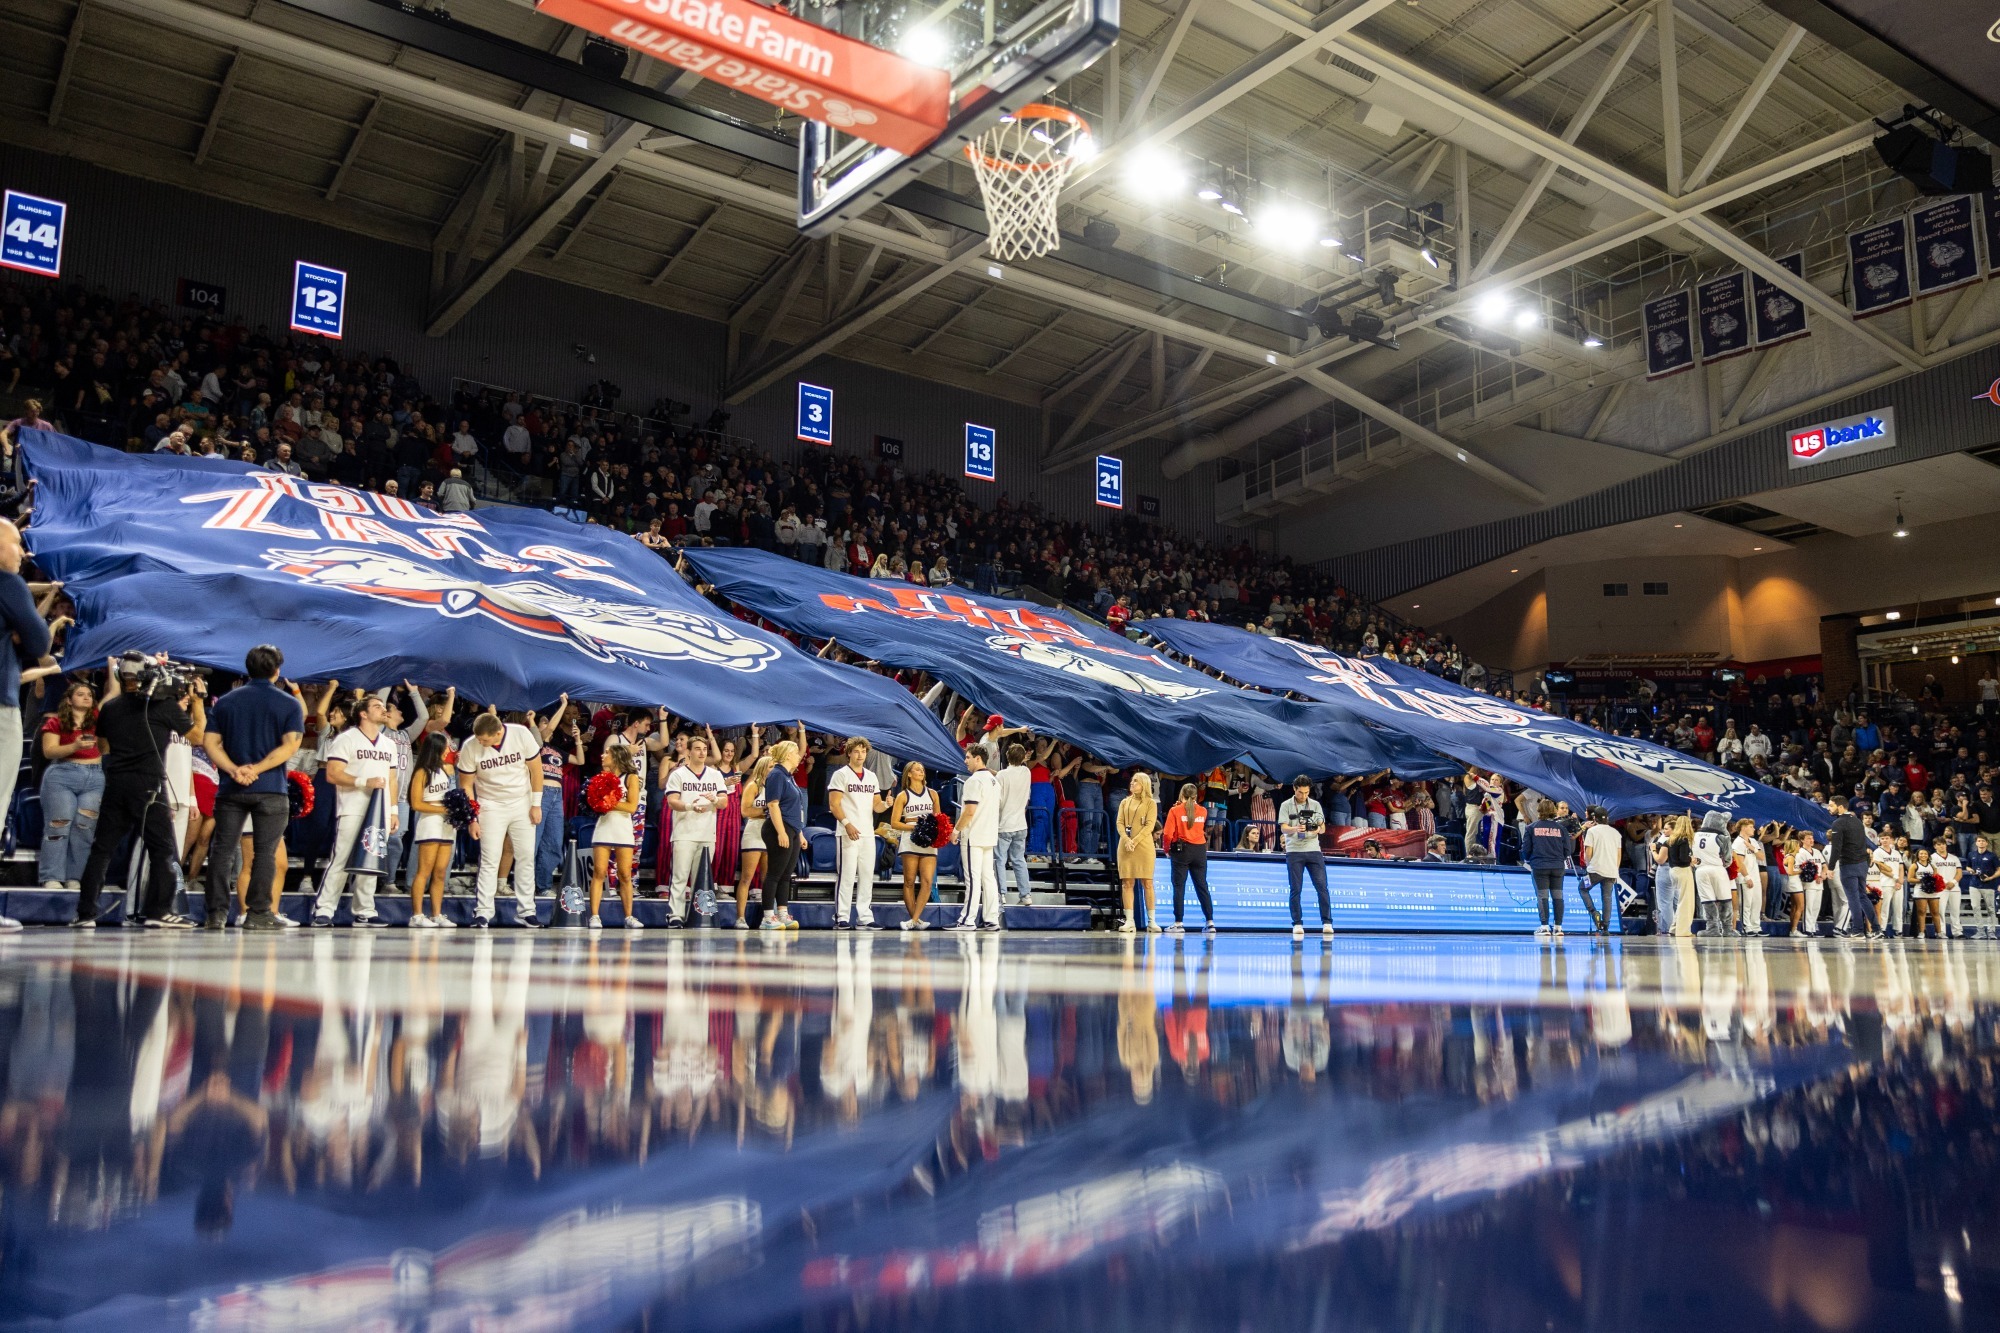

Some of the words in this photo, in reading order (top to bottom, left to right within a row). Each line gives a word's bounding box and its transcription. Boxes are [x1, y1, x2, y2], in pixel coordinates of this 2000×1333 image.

[1932, 218, 1955, 229] NCAA
[6, 217, 57, 249] 44
[1917, 231, 1941, 242] Sweet
[1867, 241, 1890, 253] NCAA
[305, 273, 337, 285] STOCKTON
[190, 288, 219, 306] 104
[301, 286, 338, 313] 12
[1712, 292, 1732, 303] WCC
[1701, 296, 1743, 315] Champions
[1658, 309, 1677, 320] WCC
[1648, 315, 1688, 332] Champions
[808, 403, 823, 422] 3
[1794, 433, 1821, 453] us
[1825, 417, 1884, 446] bank
[882, 442, 900, 455] 106
[970, 441, 991, 461] 13
[1100, 472, 1119, 490] 21
[1143, 501, 1157, 512] 107
[480, 751, 522, 770] GONZAGA
[682, 782, 718, 792] GONZAGA
[905, 803, 934, 813] GONZAG
[1533, 827, 1562, 838] GONZAGA
[1699, 838, 1707, 849] 6
